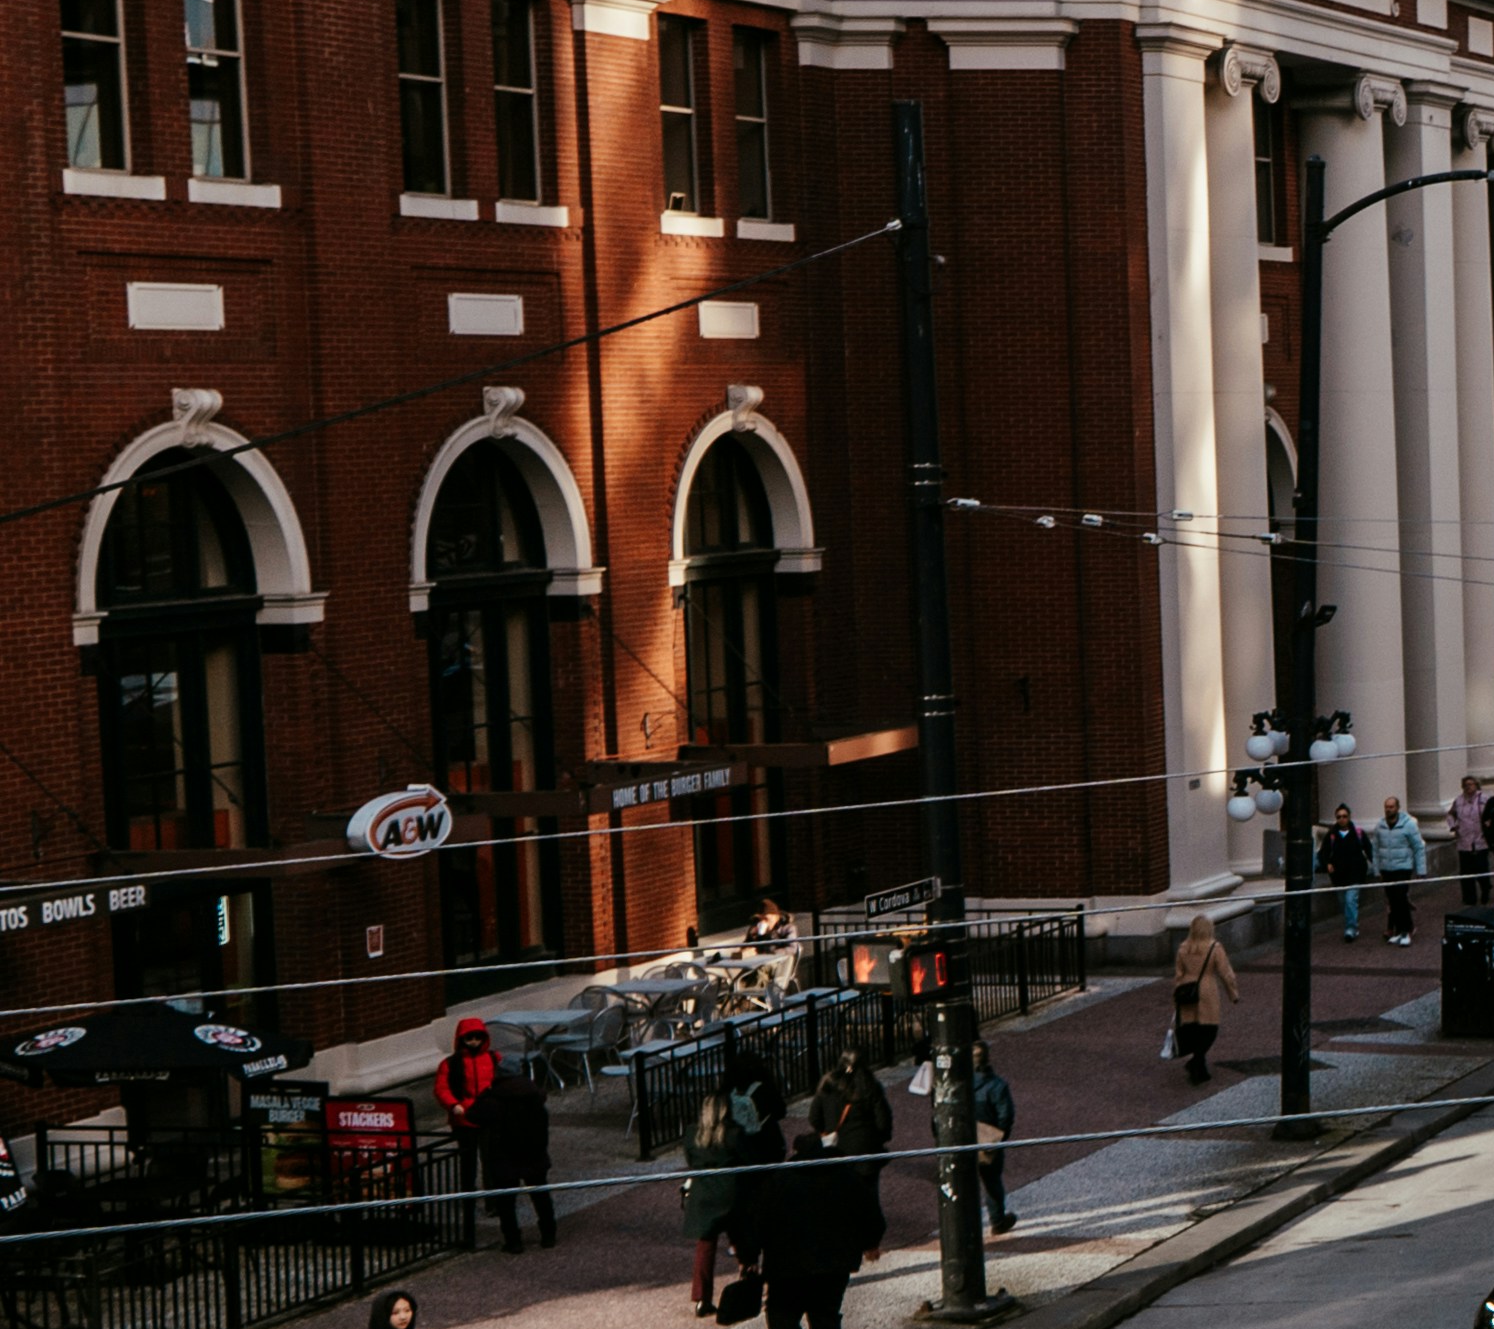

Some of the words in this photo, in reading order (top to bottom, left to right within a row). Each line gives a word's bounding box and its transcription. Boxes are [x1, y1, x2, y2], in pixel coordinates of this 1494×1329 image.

[612, 786, 638, 809] HOME
[639, 783, 651, 804] OF
[653, 780, 670, 800] THE
[671, 773, 702, 797] BURGER
[703, 767, 731, 791] FAMILY
[382, 812, 445, 849] A&W
[0, 905, 29, 931] TOS
[42, 894, 95, 923] BOWLS
[109, 885, 146, 911] BEER
[880, 892, 910, 912] Cordova
[250, 1094, 292, 1110] MASALA
[292, 1096, 321, 1112] VEGGIE
[269, 1109, 306, 1124] BURGER
[339, 1111, 395, 1128] STACKERS
